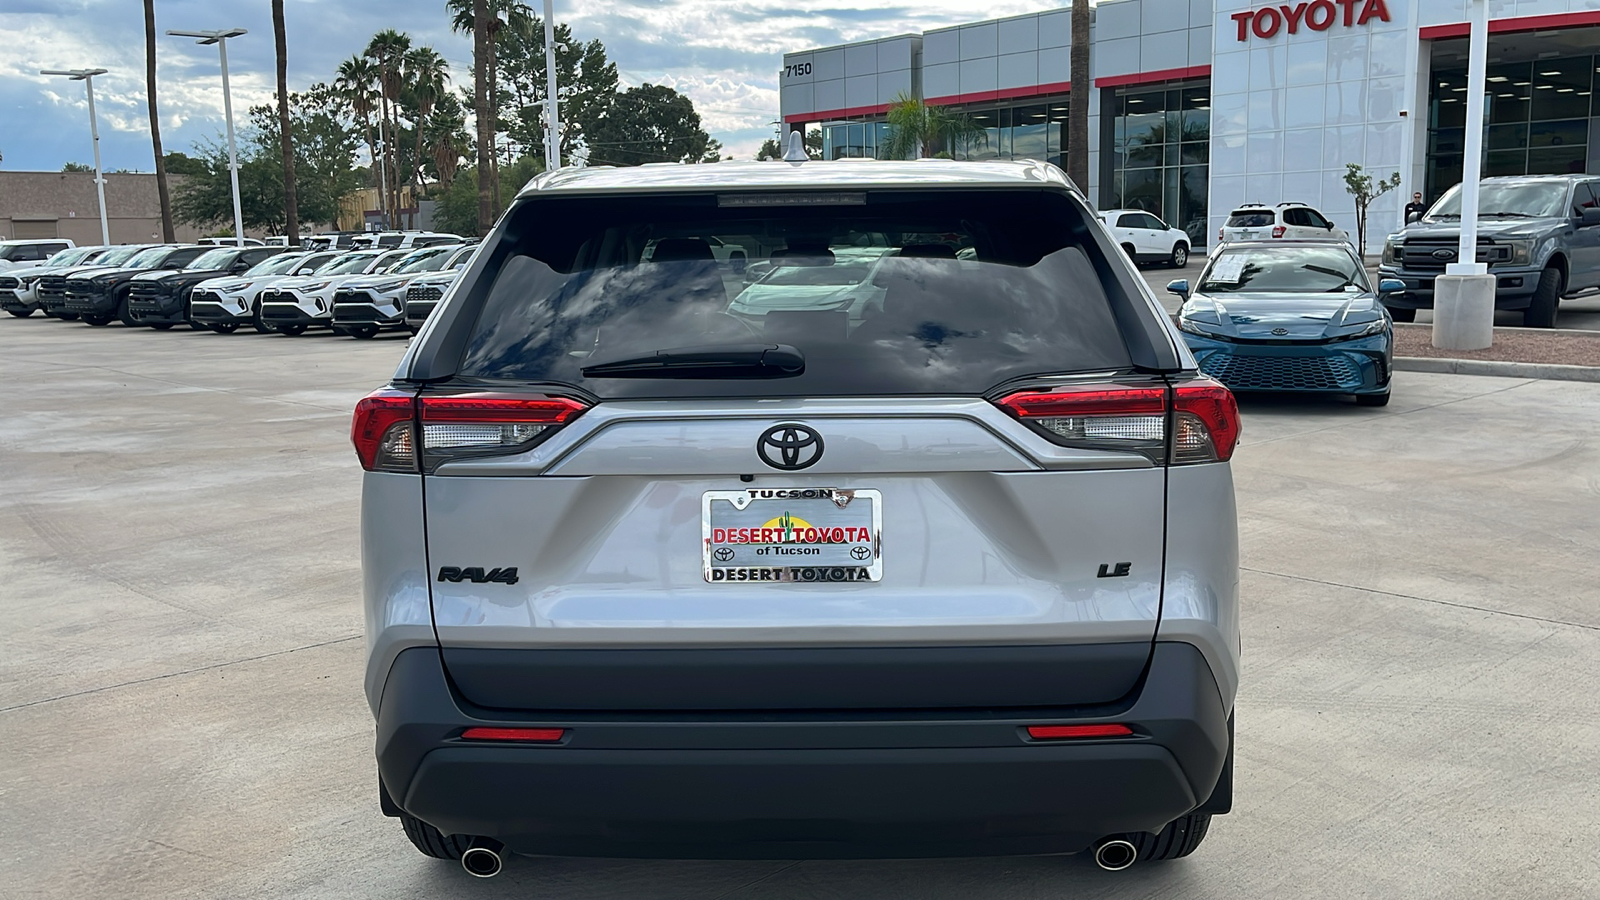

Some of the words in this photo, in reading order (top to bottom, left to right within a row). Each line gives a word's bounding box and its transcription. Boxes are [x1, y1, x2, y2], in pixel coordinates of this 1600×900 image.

[1231, 0, 1391, 42] TOYOTA
[785, 62, 812, 78] 7150
[748, 489, 833, 499] TUCSON
[713, 527, 785, 543] DESERT
[793, 527, 870, 543] TOYOTA
[756, 546, 771, 555] of
[772, 546, 820, 555] Tucson
[437, 566, 519, 585] RAV4
[712, 568, 783, 581] DESERT
[792, 567, 871, 581] TOYOTA
[1097, 561, 1132, 578] LE
